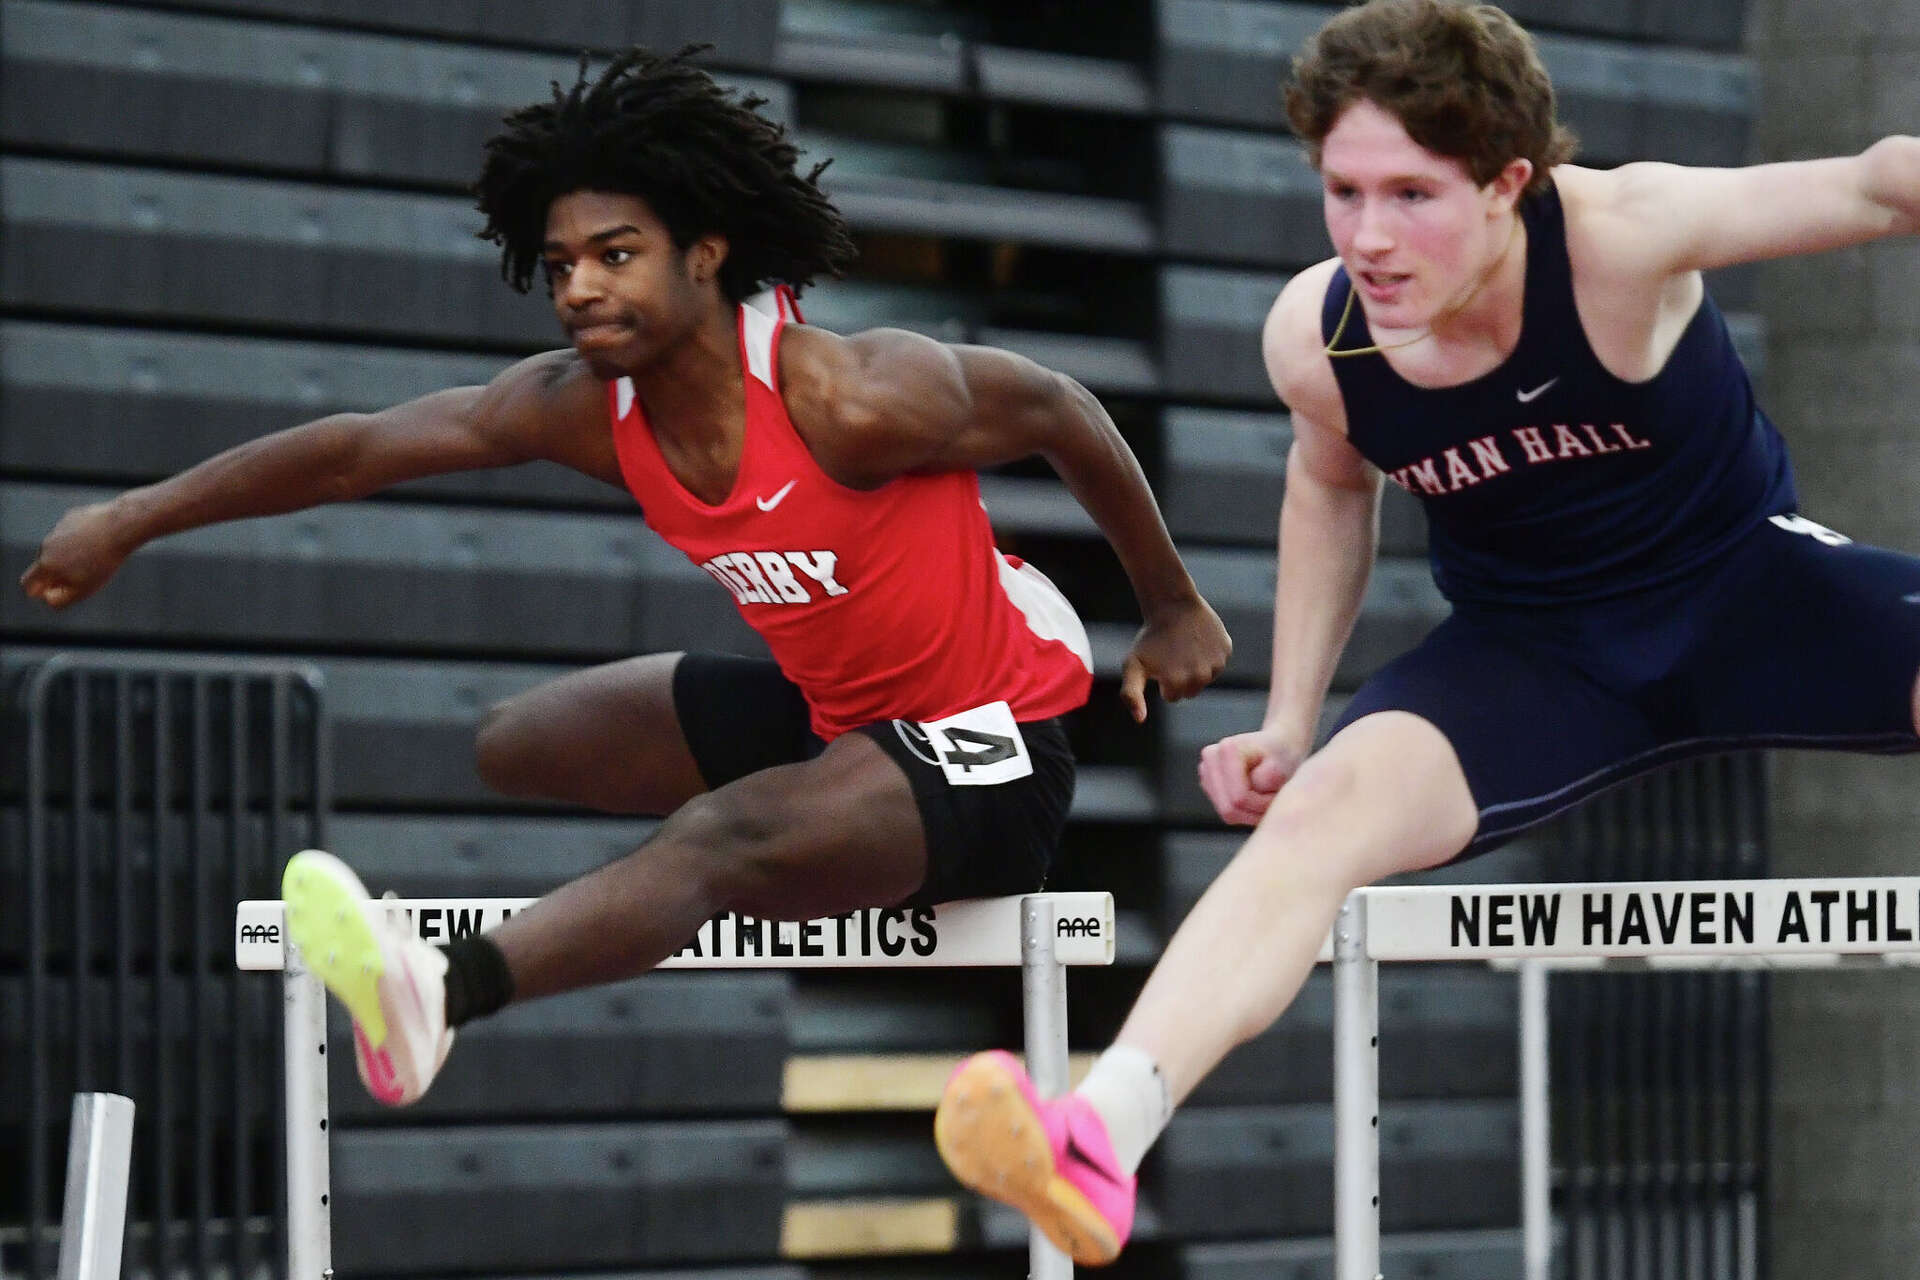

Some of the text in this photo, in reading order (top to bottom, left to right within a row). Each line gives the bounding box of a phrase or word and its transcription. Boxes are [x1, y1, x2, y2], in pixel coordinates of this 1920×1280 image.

[1512, 423, 1652, 464] HALL
[700, 549, 849, 605] DERBY
[941, 727, 1018, 773] 4
[1450, 888, 1920, 947] NEW HAVEN ATHL
